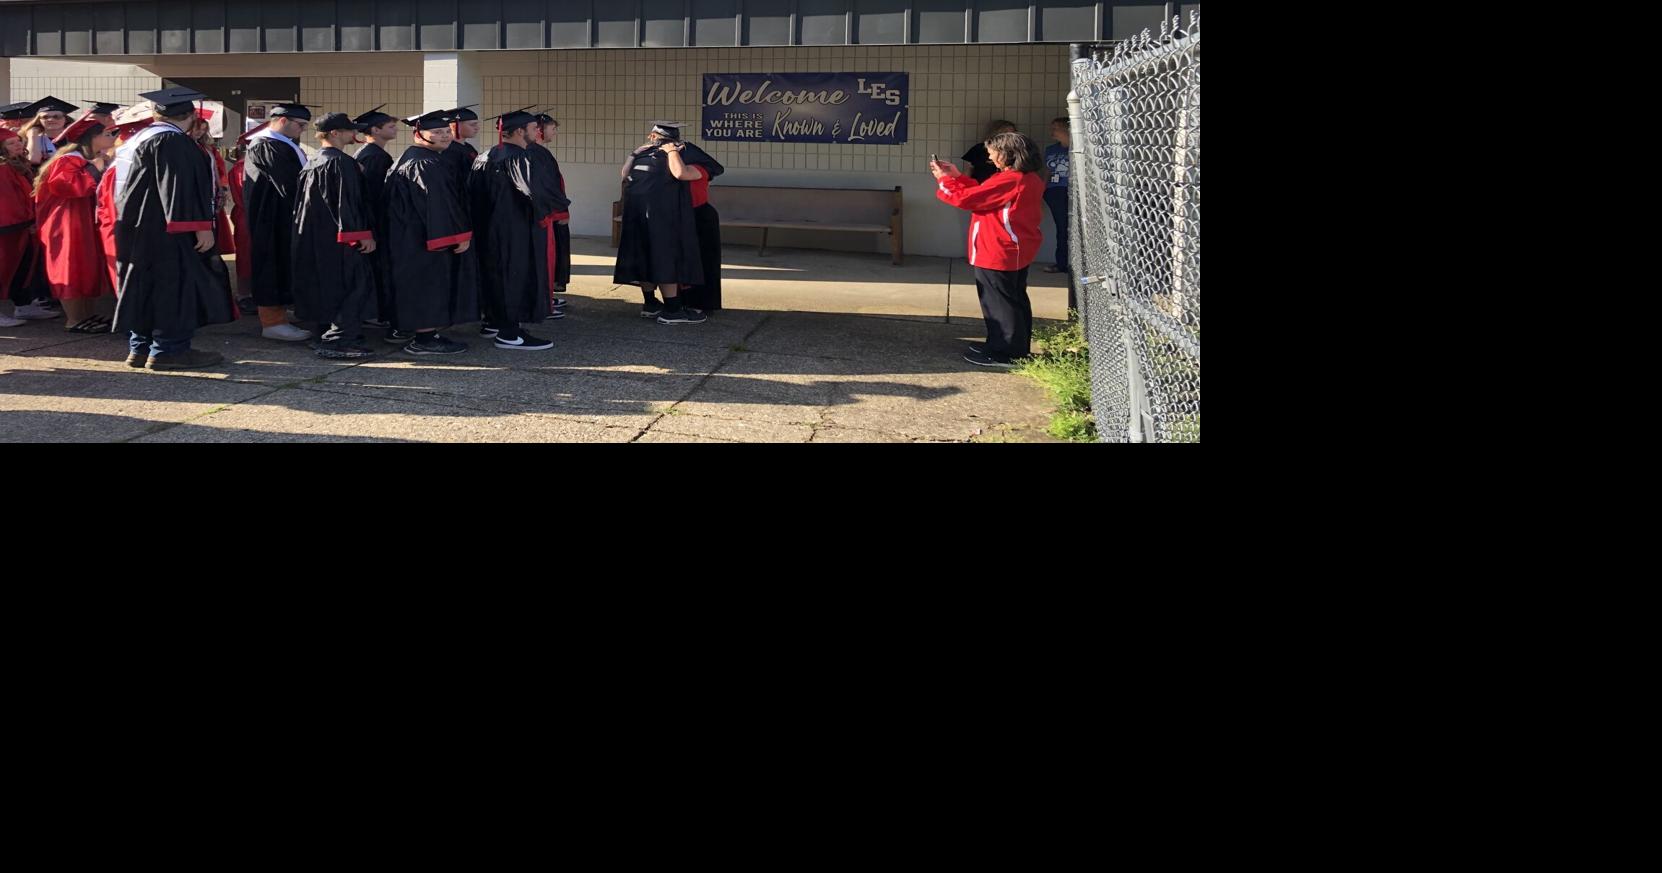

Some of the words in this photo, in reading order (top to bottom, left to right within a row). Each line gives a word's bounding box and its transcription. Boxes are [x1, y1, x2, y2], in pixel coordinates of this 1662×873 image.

[707, 80, 849, 105] Welcome
[857, 78, 901, 105] LES
[705, 128, 731, 137] YOU
[736, 129, 763, 138] ARE
[710, 120, 763, 128] WHERE
[772, 107, 825, 140] Known
[831, 119, 841, 139] &
[847, 111, 901, 141] Loved
